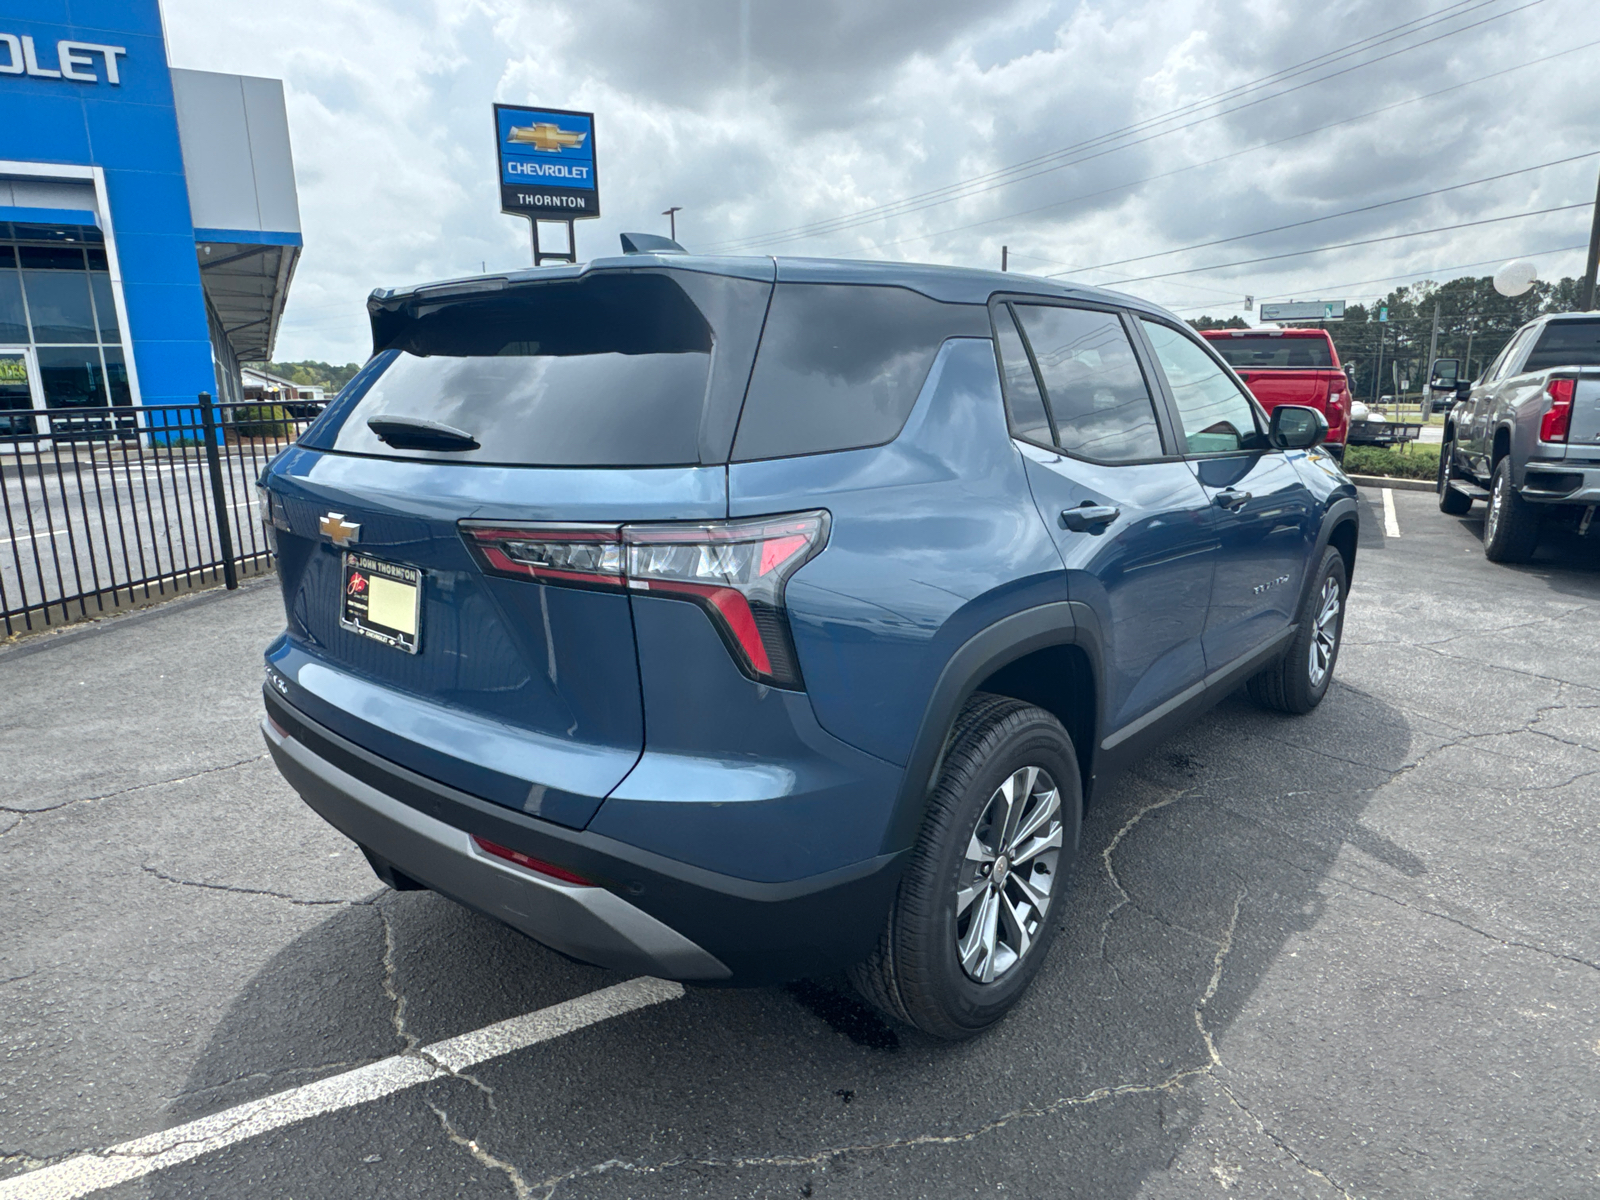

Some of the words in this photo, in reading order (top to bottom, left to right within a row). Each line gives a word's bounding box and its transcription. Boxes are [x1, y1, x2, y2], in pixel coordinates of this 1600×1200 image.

[507, 162, 589, 179] CHEVROLET
[517, 194, 586, 208] THORNTON
[360, 557, 377, 570] JOHN
